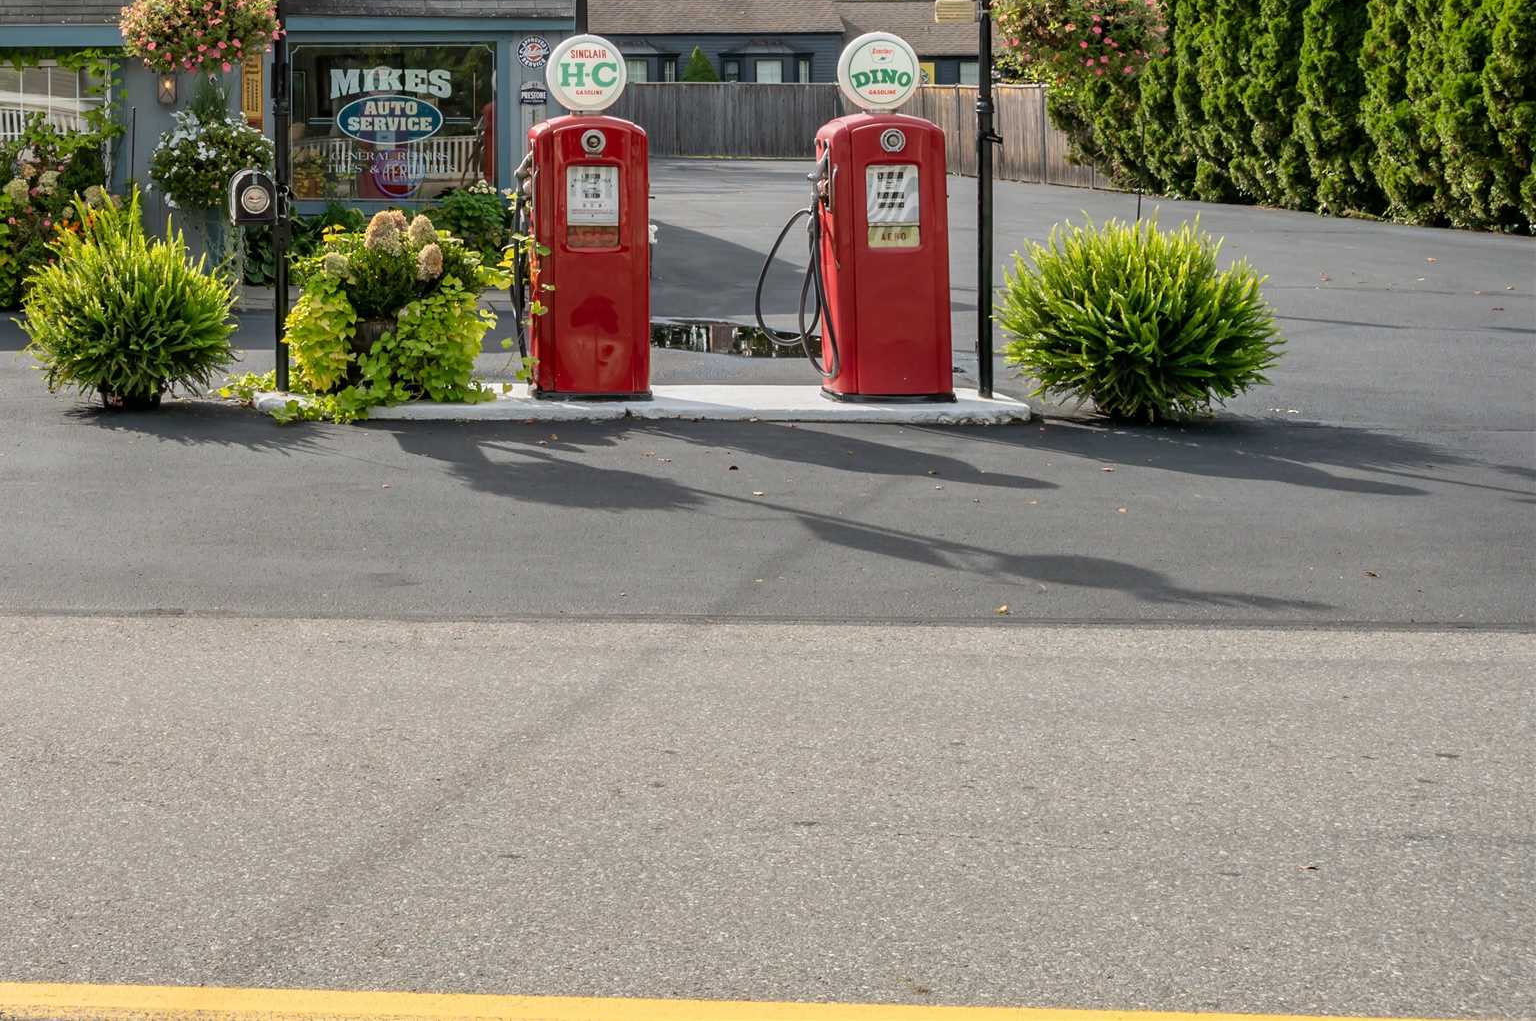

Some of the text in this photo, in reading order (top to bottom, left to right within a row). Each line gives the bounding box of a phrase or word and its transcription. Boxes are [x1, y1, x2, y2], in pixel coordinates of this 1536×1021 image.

[570, 49, 607, 59] SINCLAIR
[330, 68, 452, 99] MIKES
[852, 68, 912, 88] DINO
[364, 101, 418, 115] AUTO
[347, 116, 433, 132] SERVICE
[331, 151, 389, 161] GENERAL
[369, 165, 380, 175] &
